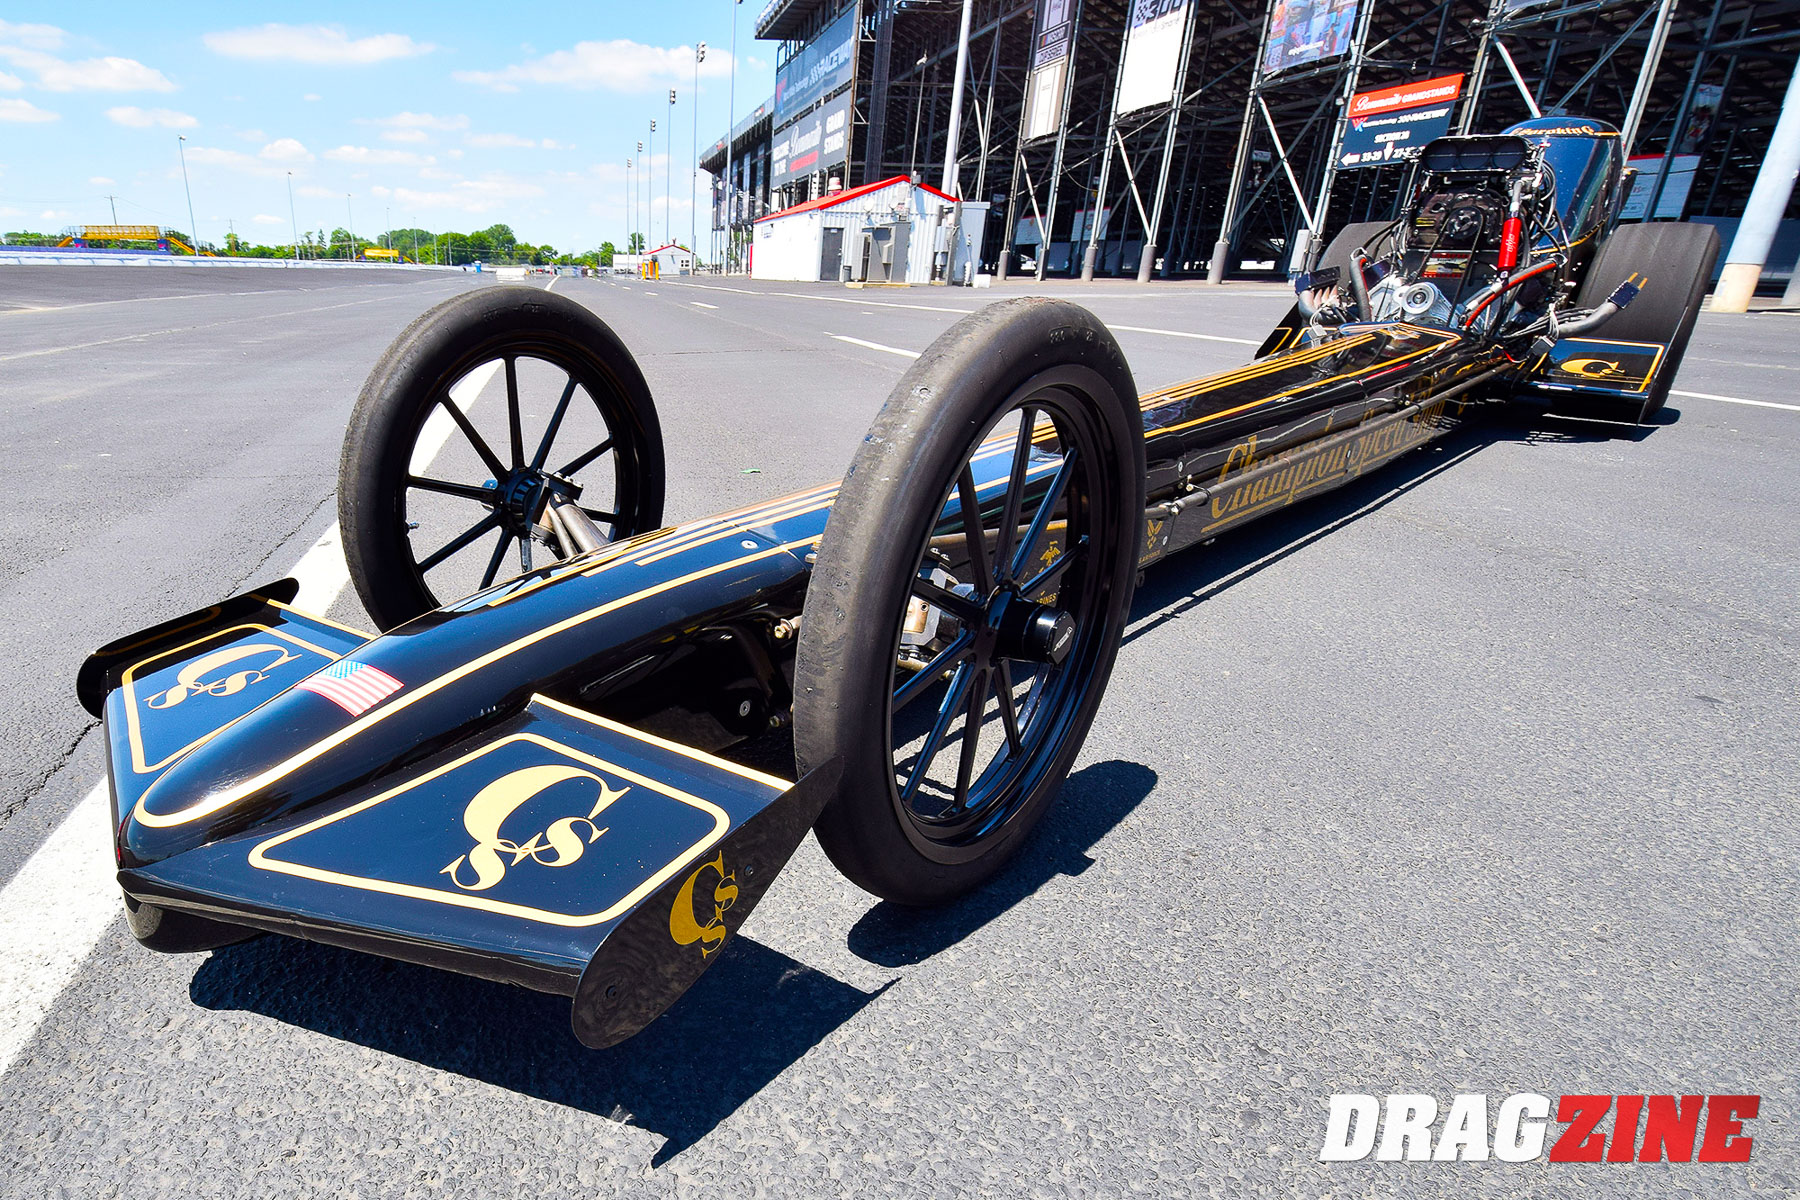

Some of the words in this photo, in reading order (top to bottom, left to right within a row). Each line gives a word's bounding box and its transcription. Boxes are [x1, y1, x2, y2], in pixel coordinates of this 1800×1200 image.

[1402, 85, 1456, 103] GRANDSTANDS
[826, 109, 845, 134] GRAND
[823, 130, 845, 155] STANDS
